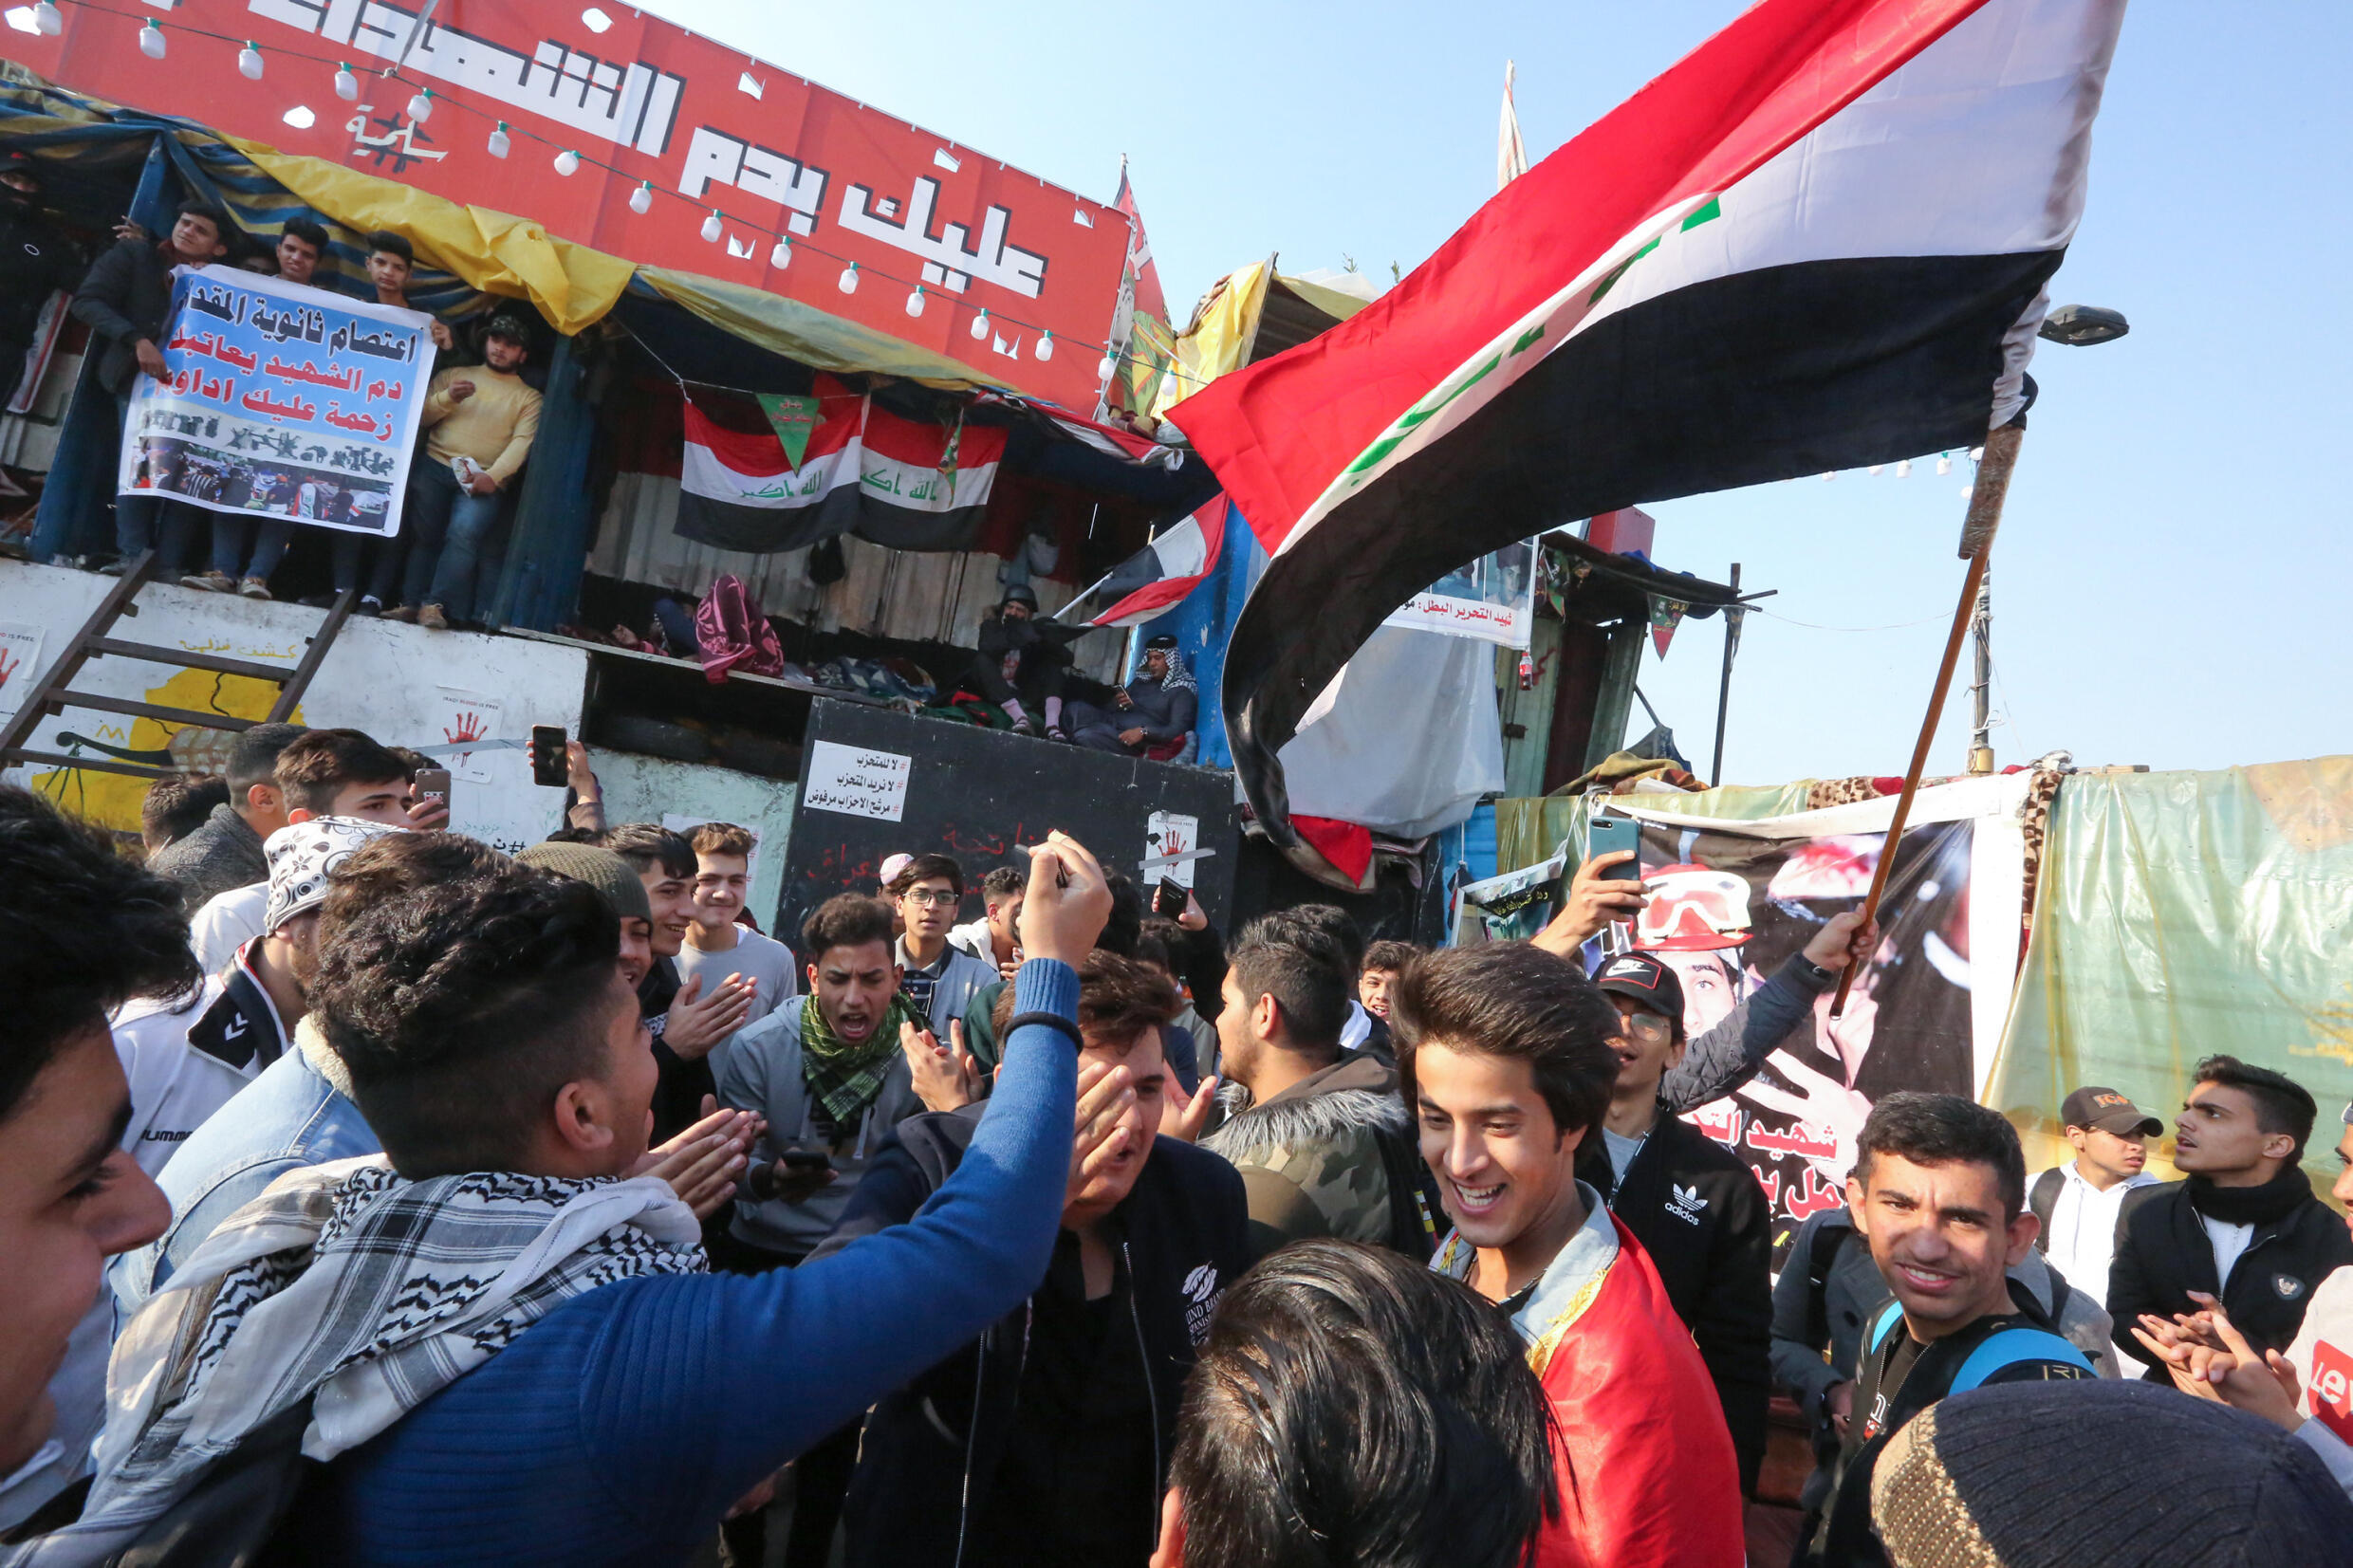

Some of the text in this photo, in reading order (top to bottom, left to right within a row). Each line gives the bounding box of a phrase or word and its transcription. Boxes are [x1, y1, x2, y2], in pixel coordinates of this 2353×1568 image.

[838, 176, 1047, 299] عليك
[250, 298, 324, 343] ثانوية
[328, 321, 416, 364] اعتصام
[265, 355, 362, 392] الشهيد
[366, 379, 402, 402] دم
[242, 389, 316, 421] عليك
[324, 401, 393, 441] زحمة
[1454, 607, 1492, 621] التحرير
[837, 772, 866, 787] المتحزب
[867, 779, 886, 793] نريد
[807, 789, 836, 806] مرفوض
[869, 798, 890, 815] مرشح
[1747, 1119, 1838, 1162] شهيد
[1664, 1201, 1700, 1226] adidas
